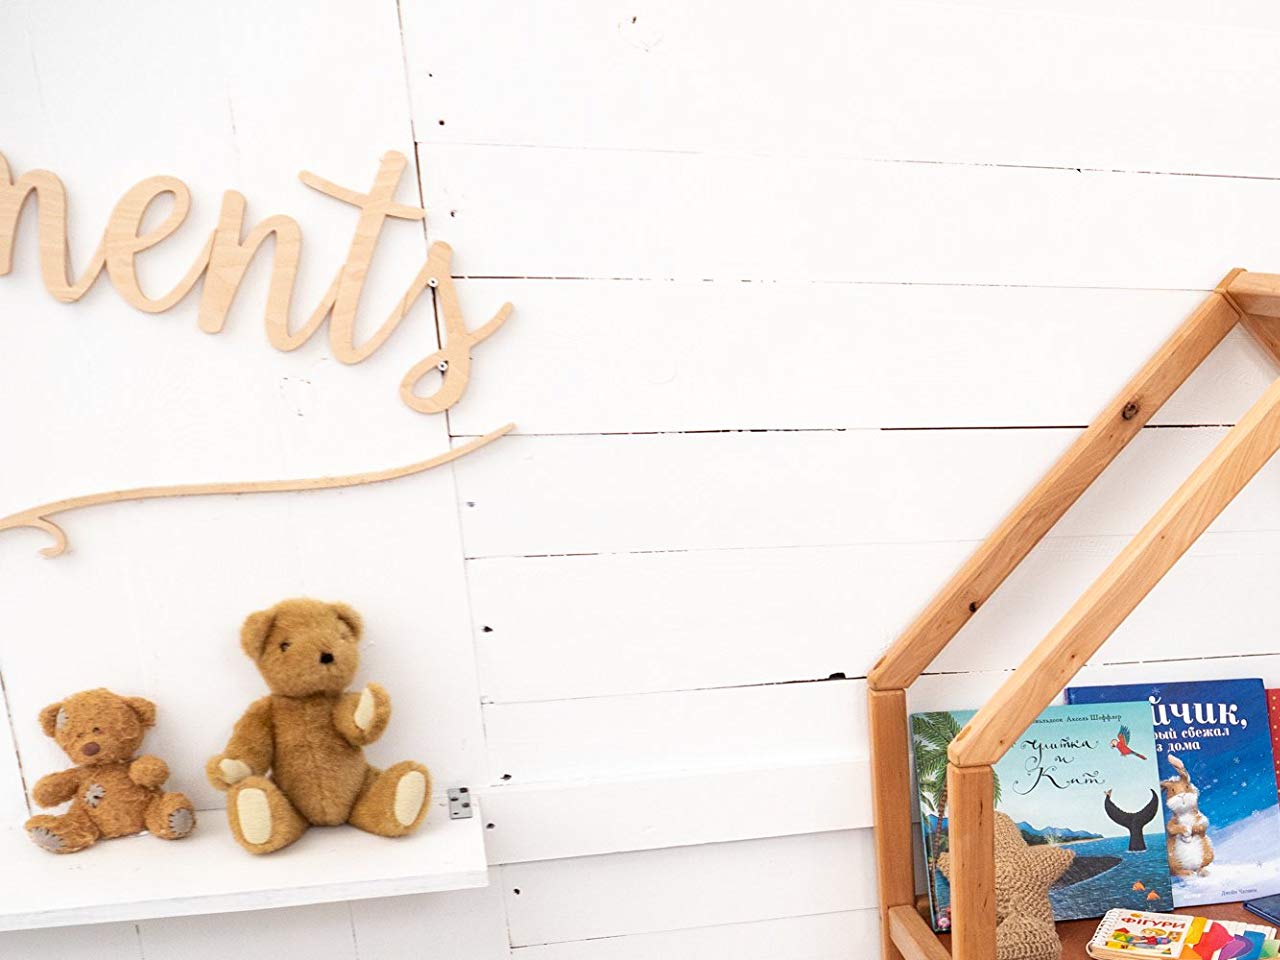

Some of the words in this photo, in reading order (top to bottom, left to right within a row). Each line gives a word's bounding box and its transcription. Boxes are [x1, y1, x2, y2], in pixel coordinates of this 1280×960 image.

[1149, 695, 1248, 729] йчик,
[1181, 726, 1230, 740] сбежал
[1167, 740, 1201, 753] дома
[1121, 916, 1187, 930] ФІГУРИ
